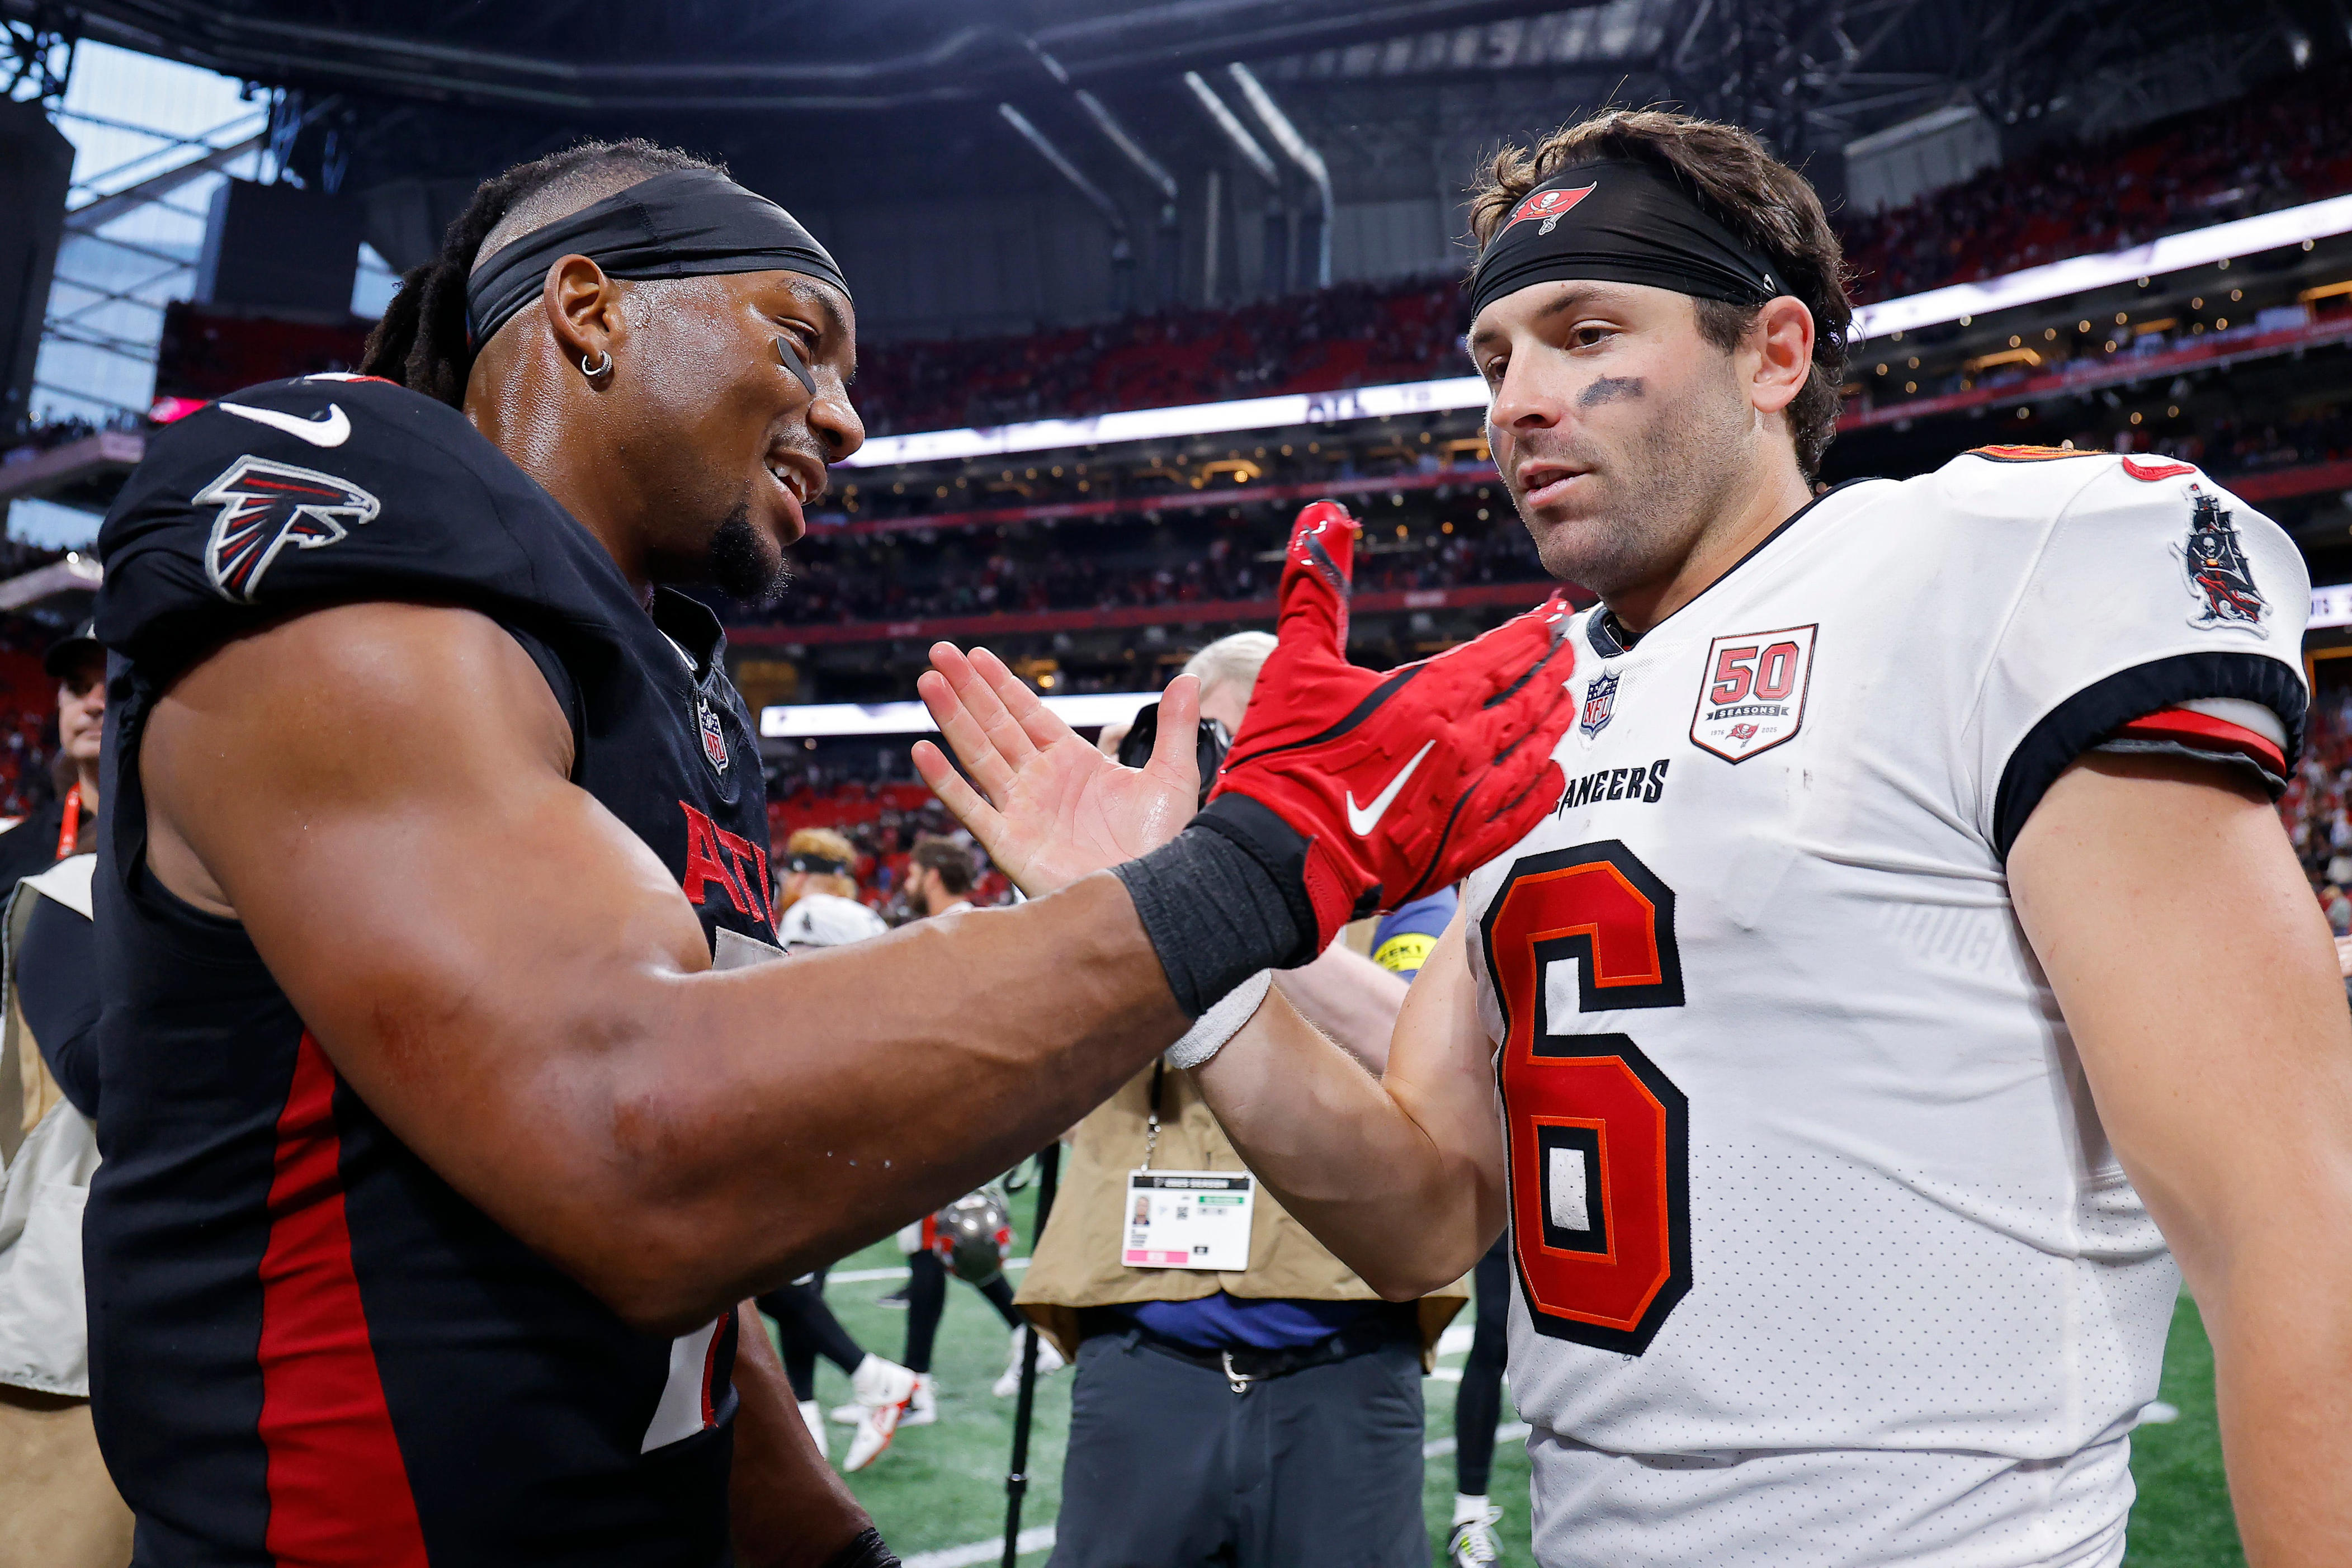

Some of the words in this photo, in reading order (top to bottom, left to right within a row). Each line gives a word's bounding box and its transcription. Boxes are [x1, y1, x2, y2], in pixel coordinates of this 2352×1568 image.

[1710, 641, 1800, 705] 50
[1584, 697, 1609, 723] NFL
[1718, 707, 1776, 717] SEASONS
[704, 730, 725, 761] NFL
[1480, 839, 1693, 1357] 6
